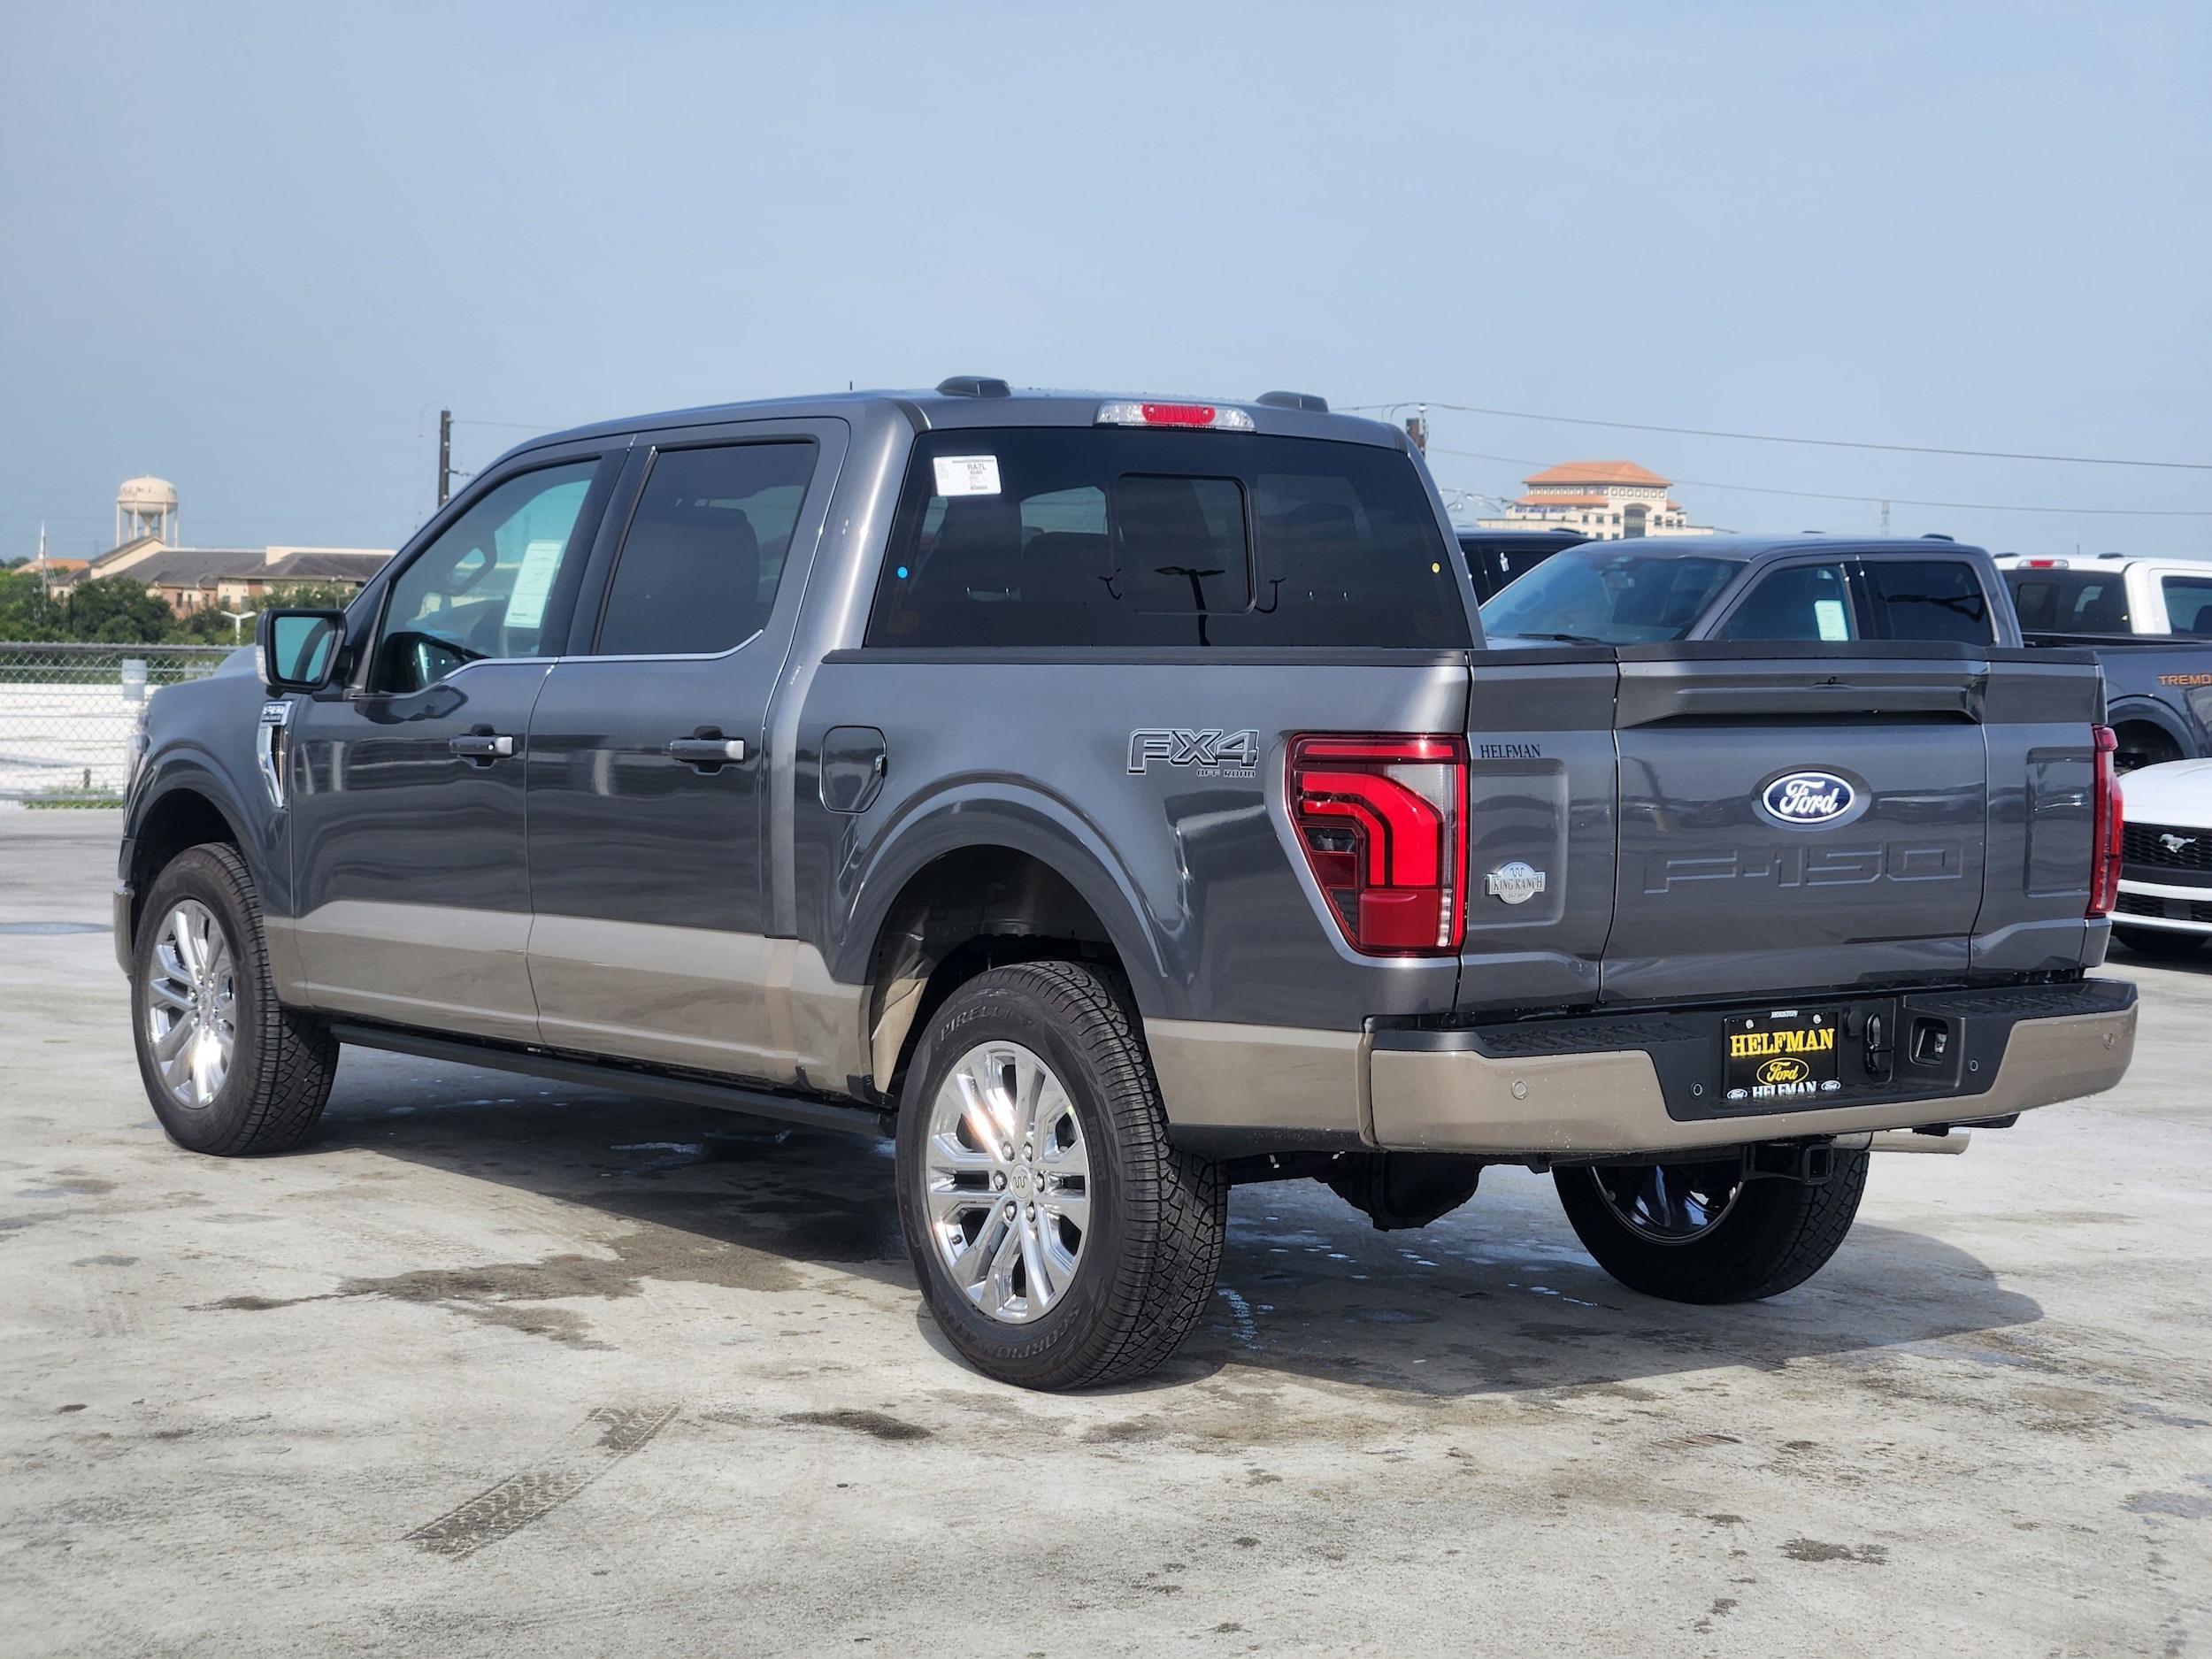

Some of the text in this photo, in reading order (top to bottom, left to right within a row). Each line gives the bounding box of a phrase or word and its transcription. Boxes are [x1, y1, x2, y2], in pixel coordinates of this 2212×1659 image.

[2157, 673, 2212, 686] TREMO
[1127, 728, 1259, 775] FX4
[1480, 744, 1540, 758] HELFMAN
[1224, 769, 1256, 778] ROAD
[1779, 780, 1839, 815] Ford
[1644, 842, 1962, 895] F-150
[1494, 876, 1542, 890] KING RANCH
[941, 1006, 1013, 1041] PIRELLI
[1730, 1028, 1835, 1057] HELFMAN
[1766, 1062, 1800, 1082] Ford
[1752, 1081, 1817, 1098] HELFMAN
